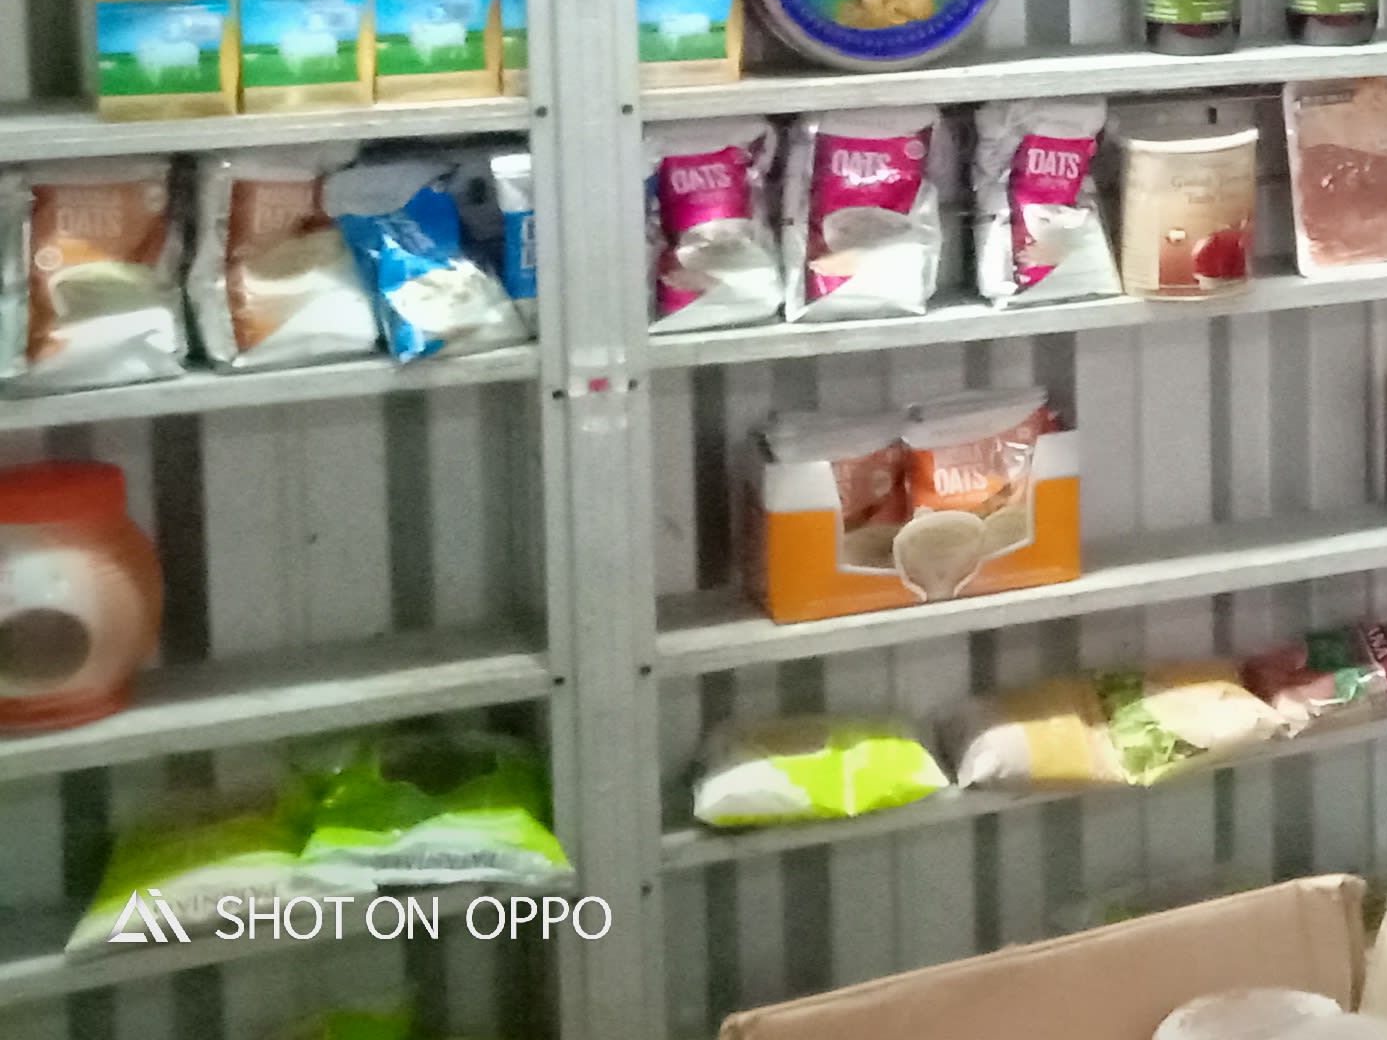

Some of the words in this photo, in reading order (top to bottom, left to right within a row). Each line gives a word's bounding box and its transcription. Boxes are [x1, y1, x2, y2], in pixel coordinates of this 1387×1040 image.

[670, 162, 732, 195] OATS
[1027, 147, 1080, 180] OATS
[933, 467, 989, 497] OATS
